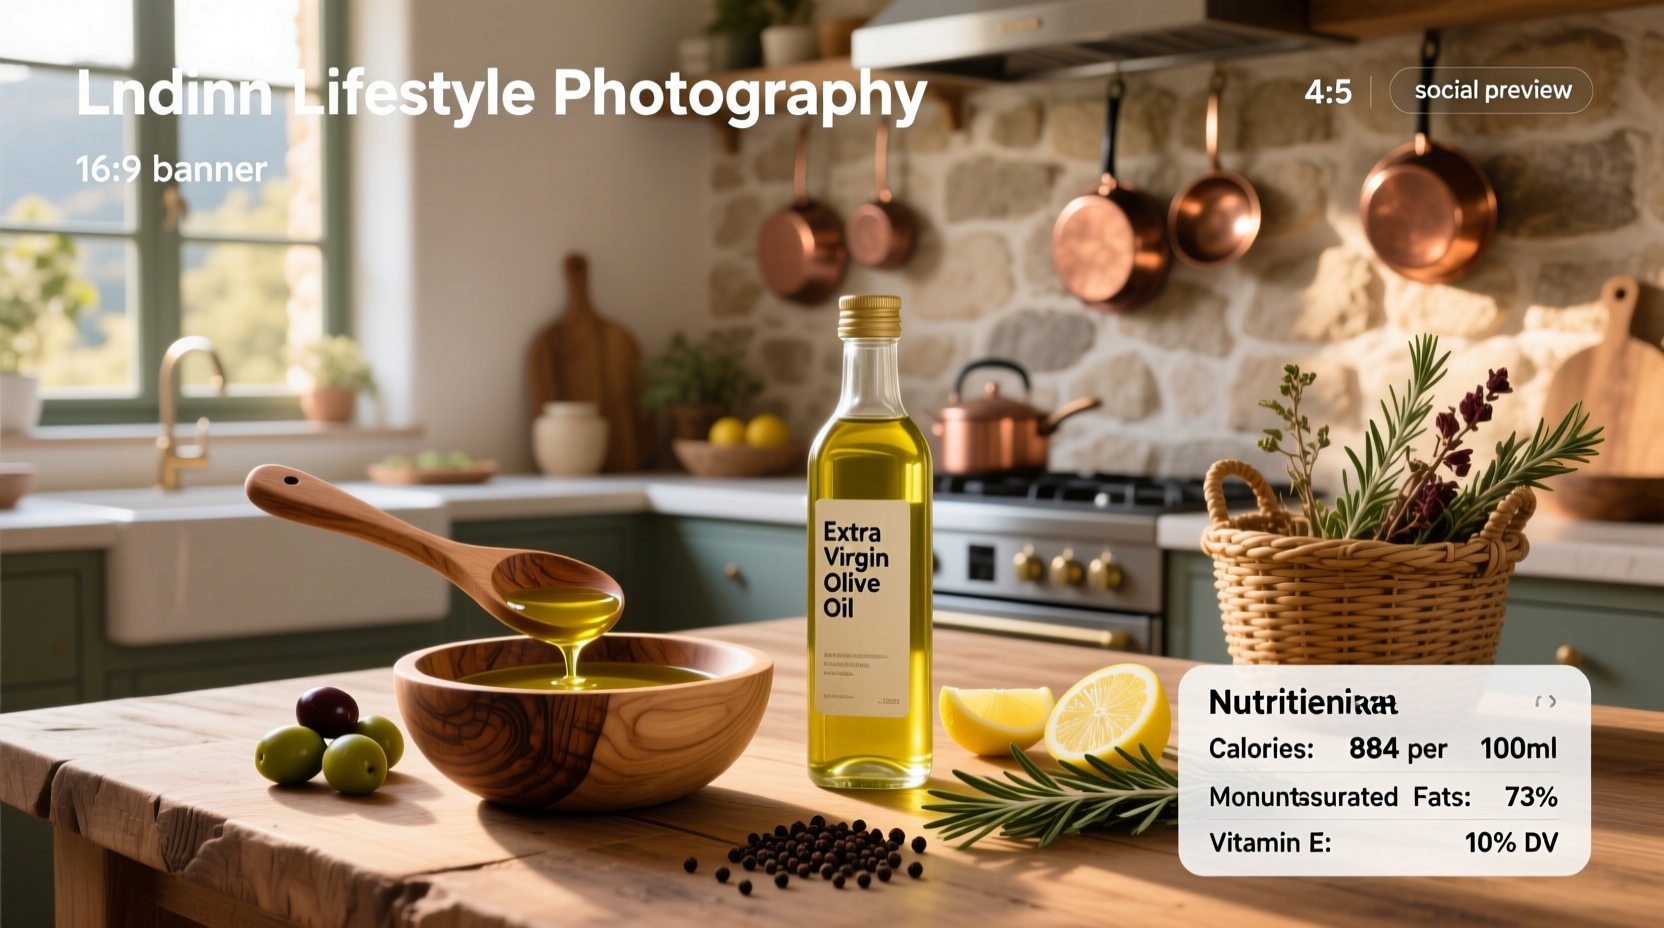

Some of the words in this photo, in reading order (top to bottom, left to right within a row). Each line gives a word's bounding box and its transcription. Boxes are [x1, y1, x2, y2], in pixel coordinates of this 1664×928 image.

[824, 521, 881, 543] Extra
[824, 546, 889, 573] Virgin
[823, 571, 881, 593] Olive
[823, 597, 854, 618] Oil
